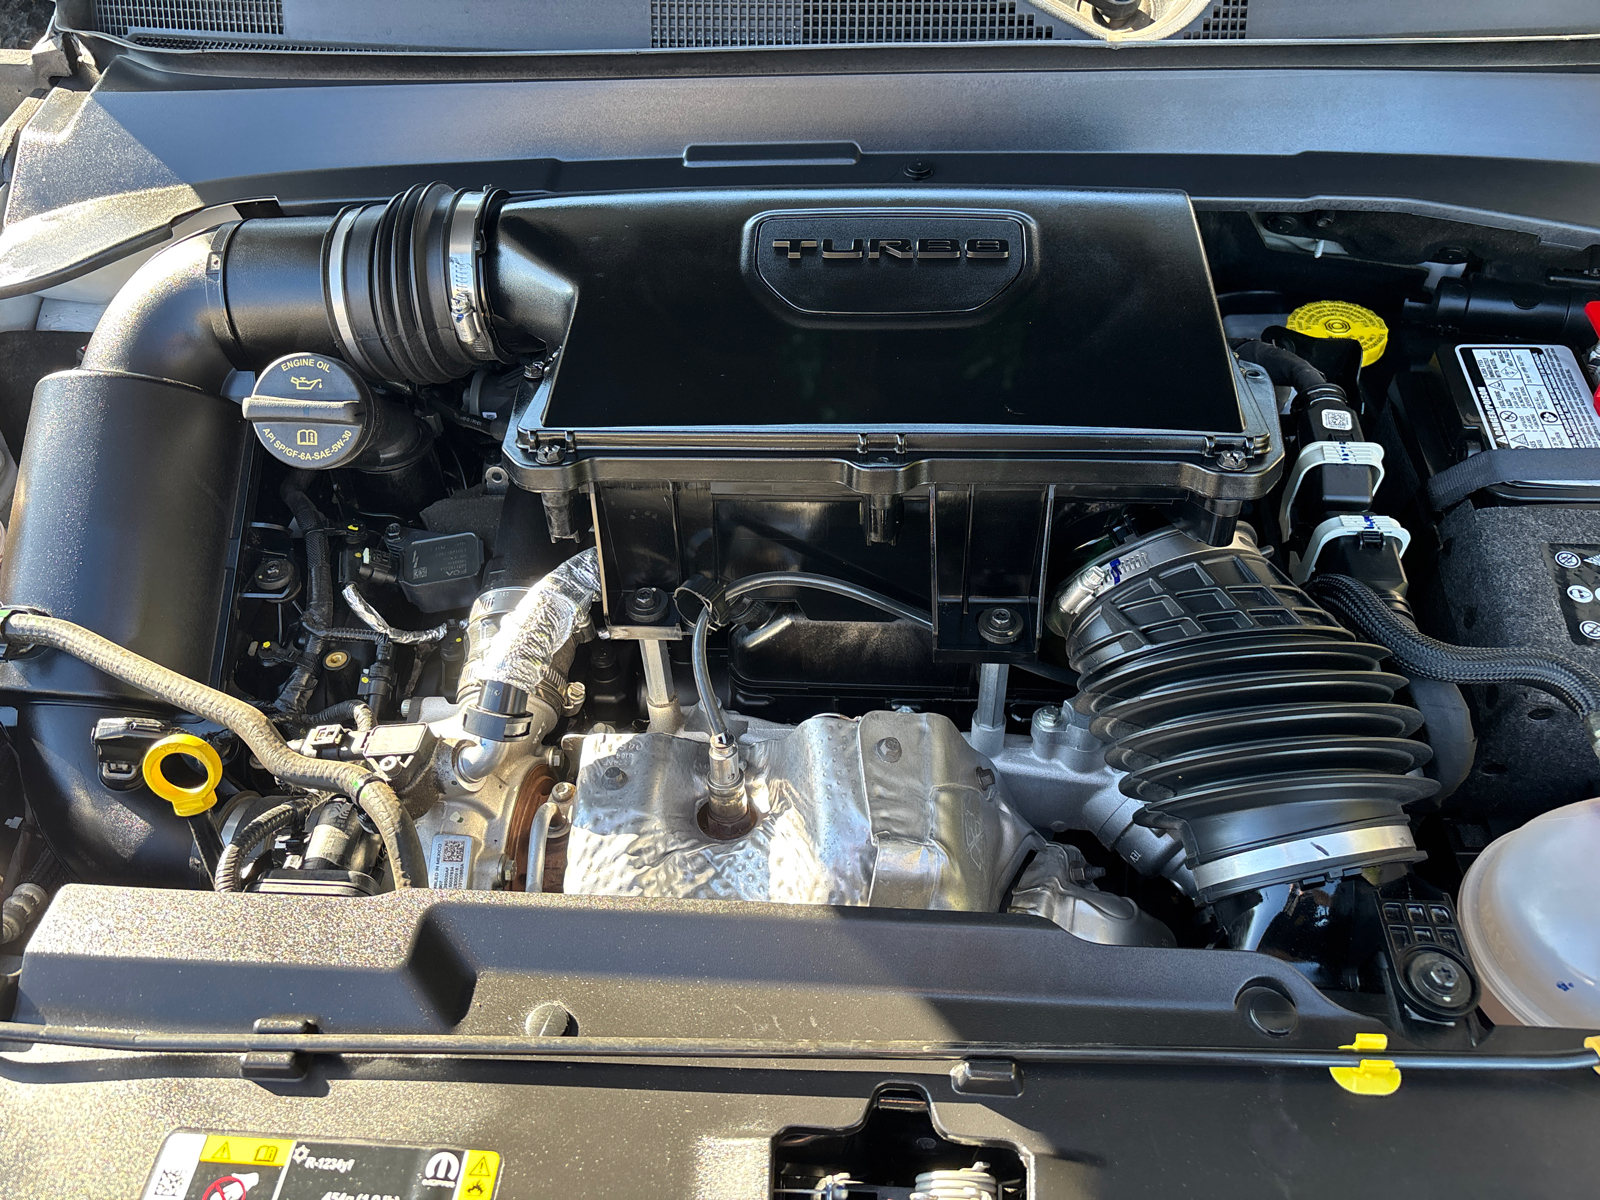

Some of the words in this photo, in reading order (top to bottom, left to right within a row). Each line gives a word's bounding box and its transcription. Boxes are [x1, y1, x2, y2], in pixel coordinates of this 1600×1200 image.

[281, 358, 315, 372] ENGINE
[316, 360, 331, 373] OIL
[1477, 386, 1504, 437] DANGER/POISON
[262, 428, 277, 443] API
[273, 430, 352, 461] SP/GF-6A-SAE-5W-30
